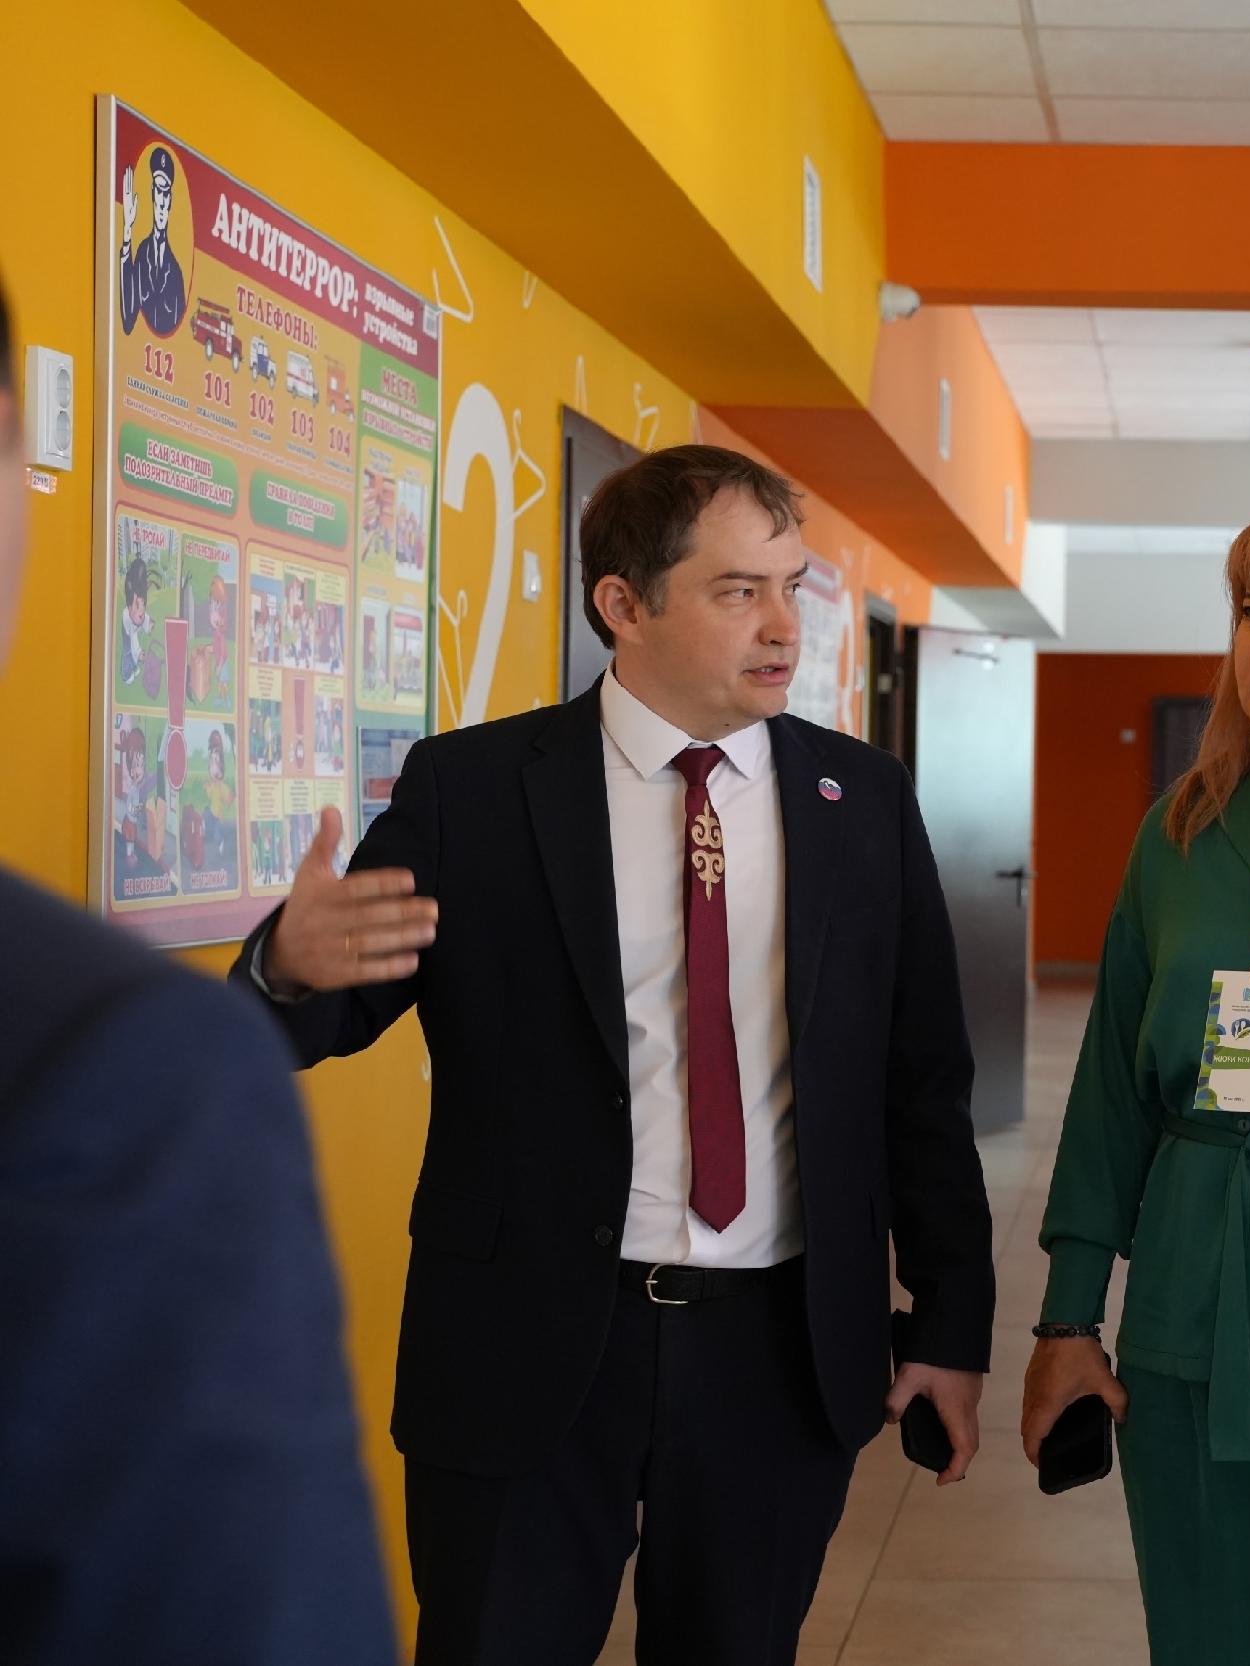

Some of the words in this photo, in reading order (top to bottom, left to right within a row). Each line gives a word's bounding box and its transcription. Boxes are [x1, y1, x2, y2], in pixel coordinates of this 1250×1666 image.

[211, 192, 359, 319] АНТИТЕРРОР:
[236, 284, 319, 352] ТЕЛЕФОНЫ:
[144, 344, 174, 384] 112
[204, 371, 231, 407] 101
[250, 392, 275, 425] 102
[291, 409, 314, 443] 103
[329, 426, 351, 457] 104
[147, 439, 170, 461] ЕСЛИ
[170, 444, 213, 479] ЗАМЕТИШЬ
[124, 453, 200, 496] ПОДОЗРИТЕЛЬНЫЙ
[199, 479, 234, 507] ПРЕДМЕТ
